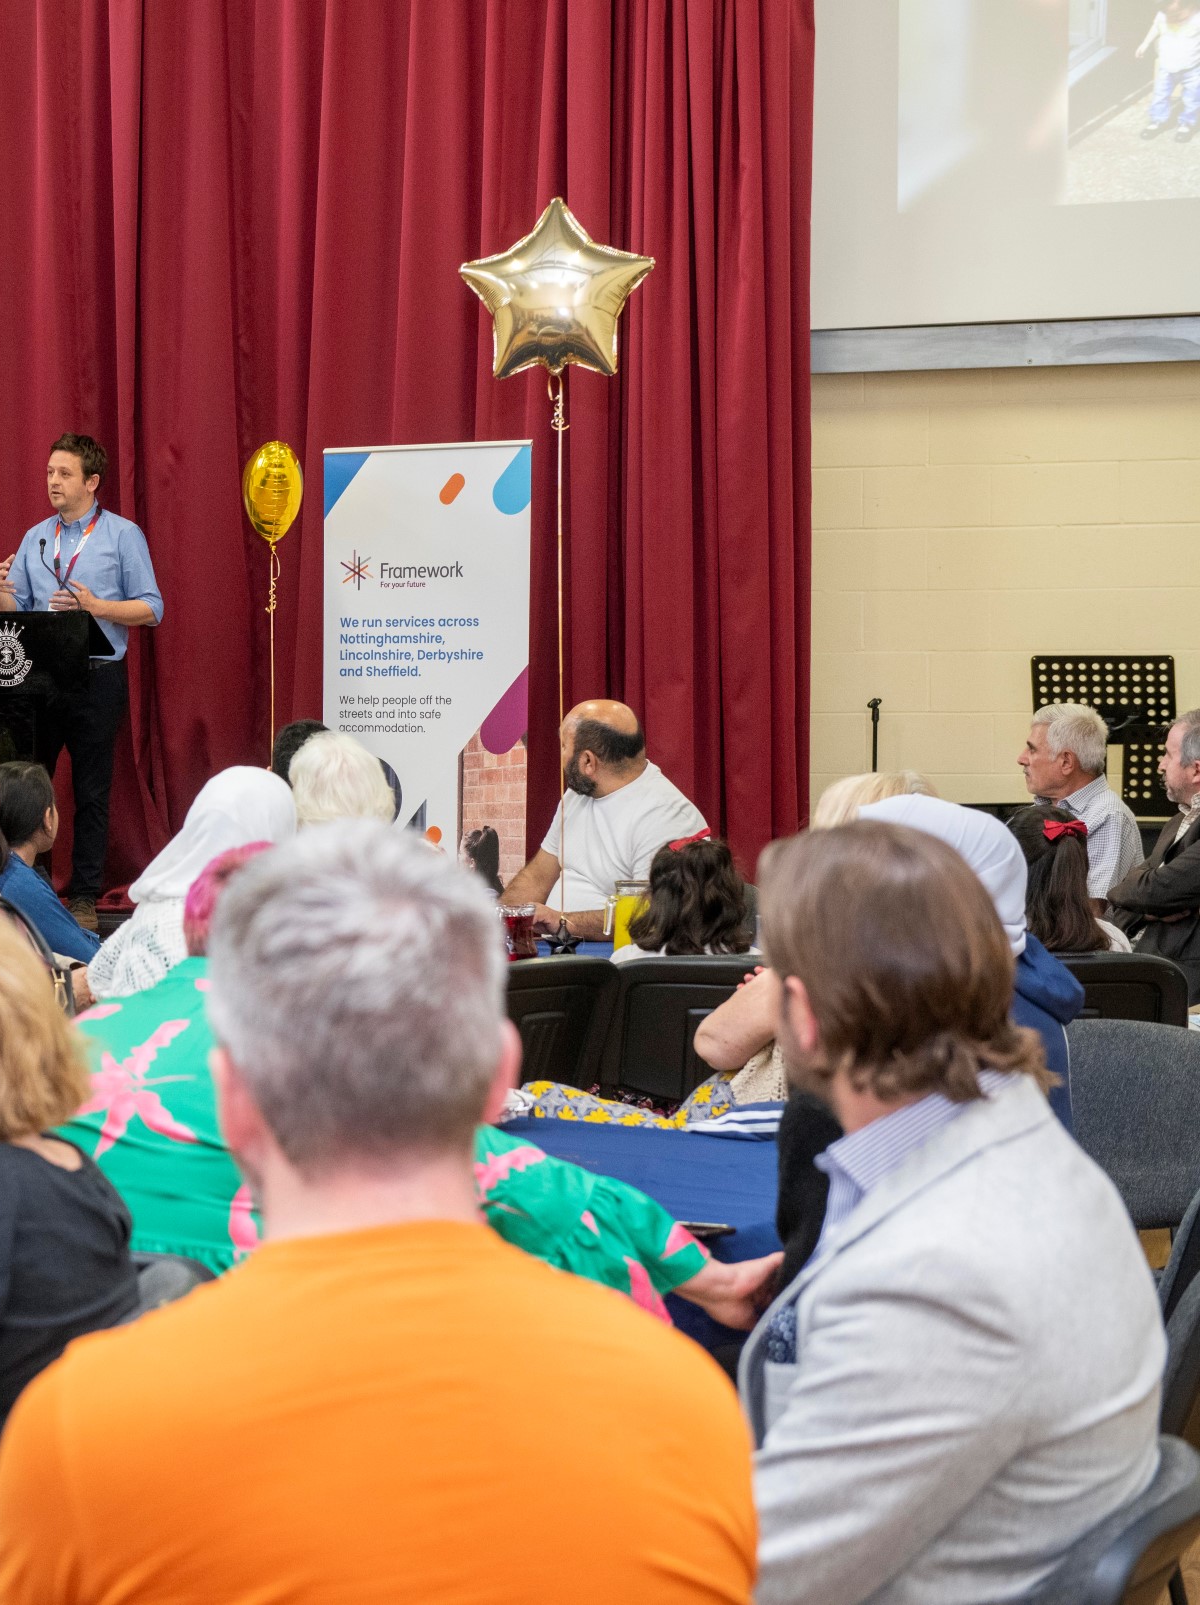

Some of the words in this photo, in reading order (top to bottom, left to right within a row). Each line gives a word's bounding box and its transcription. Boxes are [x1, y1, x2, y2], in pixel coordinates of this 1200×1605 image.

[381, 561, 463, 579] Framework
[392, 582, 406, 590] your
[406, 580, 426, 588] future
[340, 618, 360, 628] We
[362, 618, 383, 628] run
[386, 617, 435, 628] services
[438, 618, 479, 627] across
[340, 632, 445, 647] Nottinghamshire,
[340, 649, 414, 661] Lincolnshire,
[418, 649, 483, 663] Derbyshire
[340, 666, 362, 676] and
[366, 665, 421, 676] Sheffield.
[339, 696, 355, 704] We
[358, 695, 379, 707] help
[383, 695, 416, 707] people
[420, 695, 432, 704] off
[435, 696, 451, 705] the
[339, 709, 372, 718] streets
[375, 709, 395, 718] and
[398, 709, 416, 718] into
[420, 709, 441, 719] safe
[339, 723, 426, 733] accommodation.
